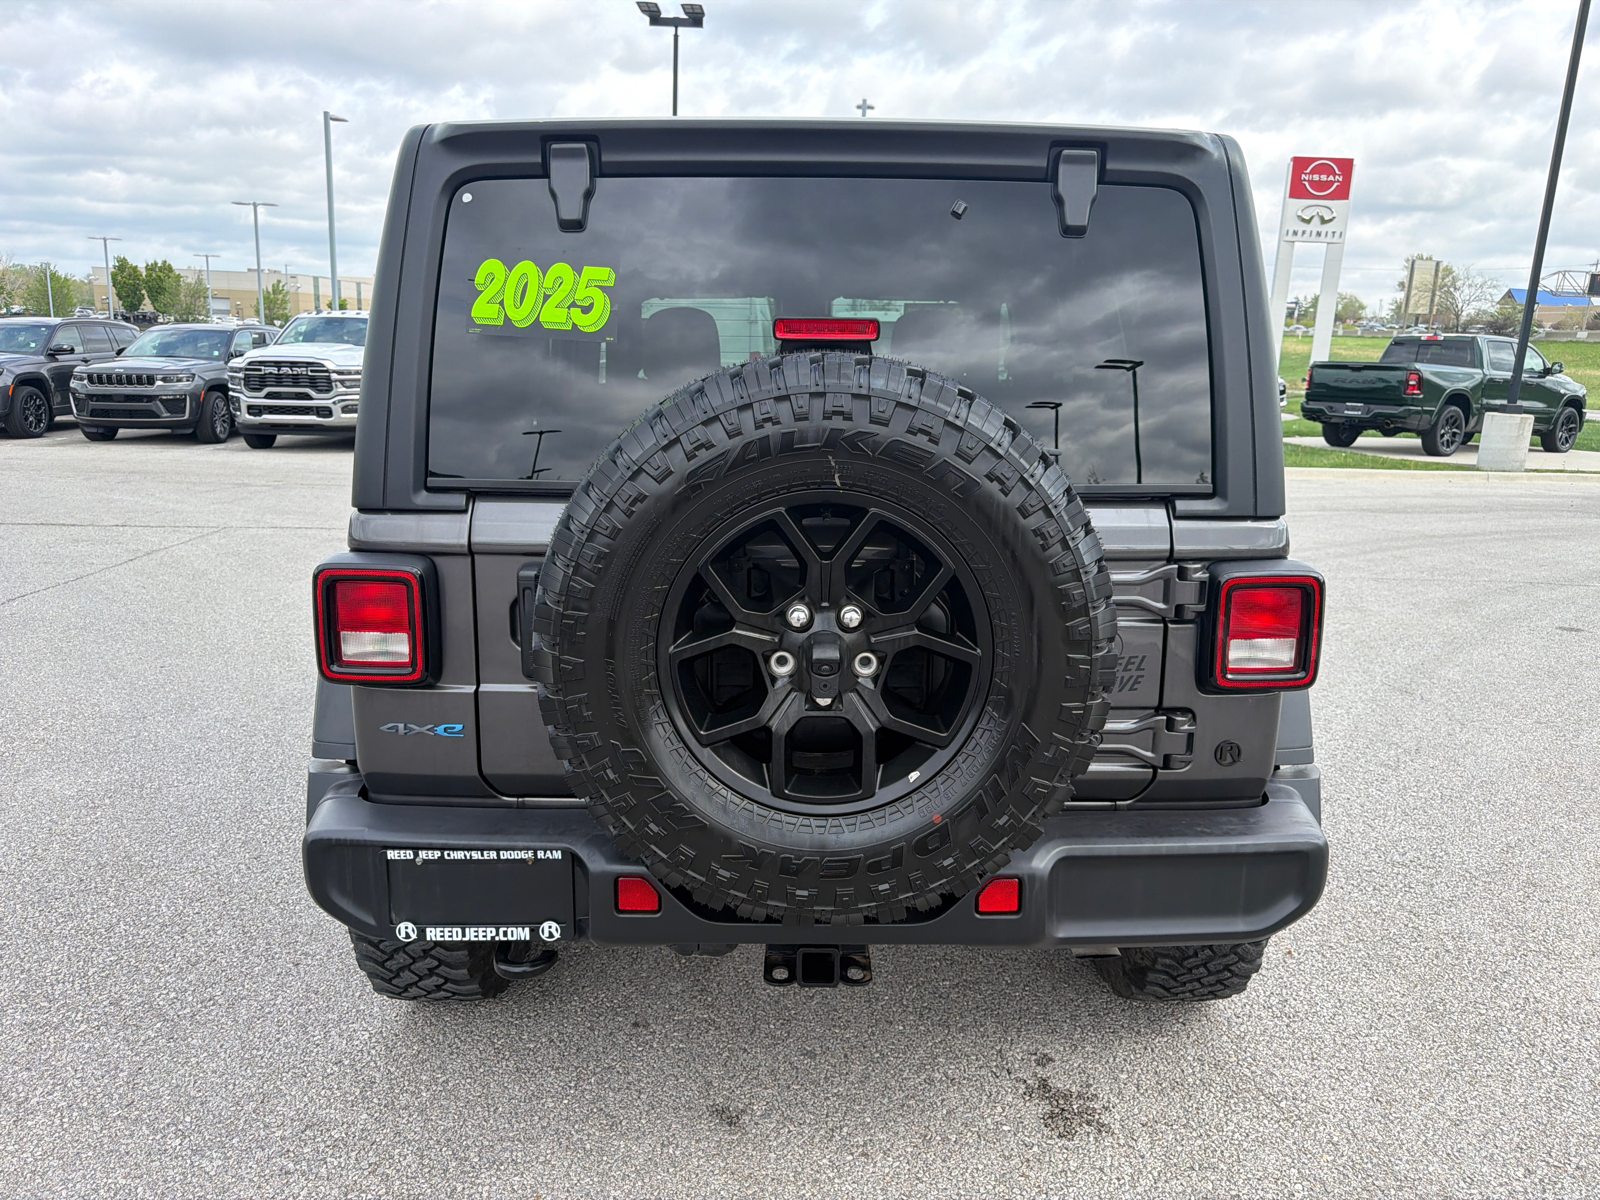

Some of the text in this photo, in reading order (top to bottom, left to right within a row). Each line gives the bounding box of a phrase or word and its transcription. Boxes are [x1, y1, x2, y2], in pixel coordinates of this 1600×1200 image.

[1301, 173, 1343, 182] NISSAN
[1285, 228, 1344, 239] INFINITI
[471, 258, 616, 333] 2025
[264, 366, 307, 375] RAM
[1333, 377, 1377, 385] RAM
[674, 426, 983, 499] FALKEN
[721, 722, 1042, 881] WILDPEAK
[387, 850, 562, 860] REED JEEP CHRYSLER DODGE RAM
[426, 927, 530, 941] REEDJEEP.COM
